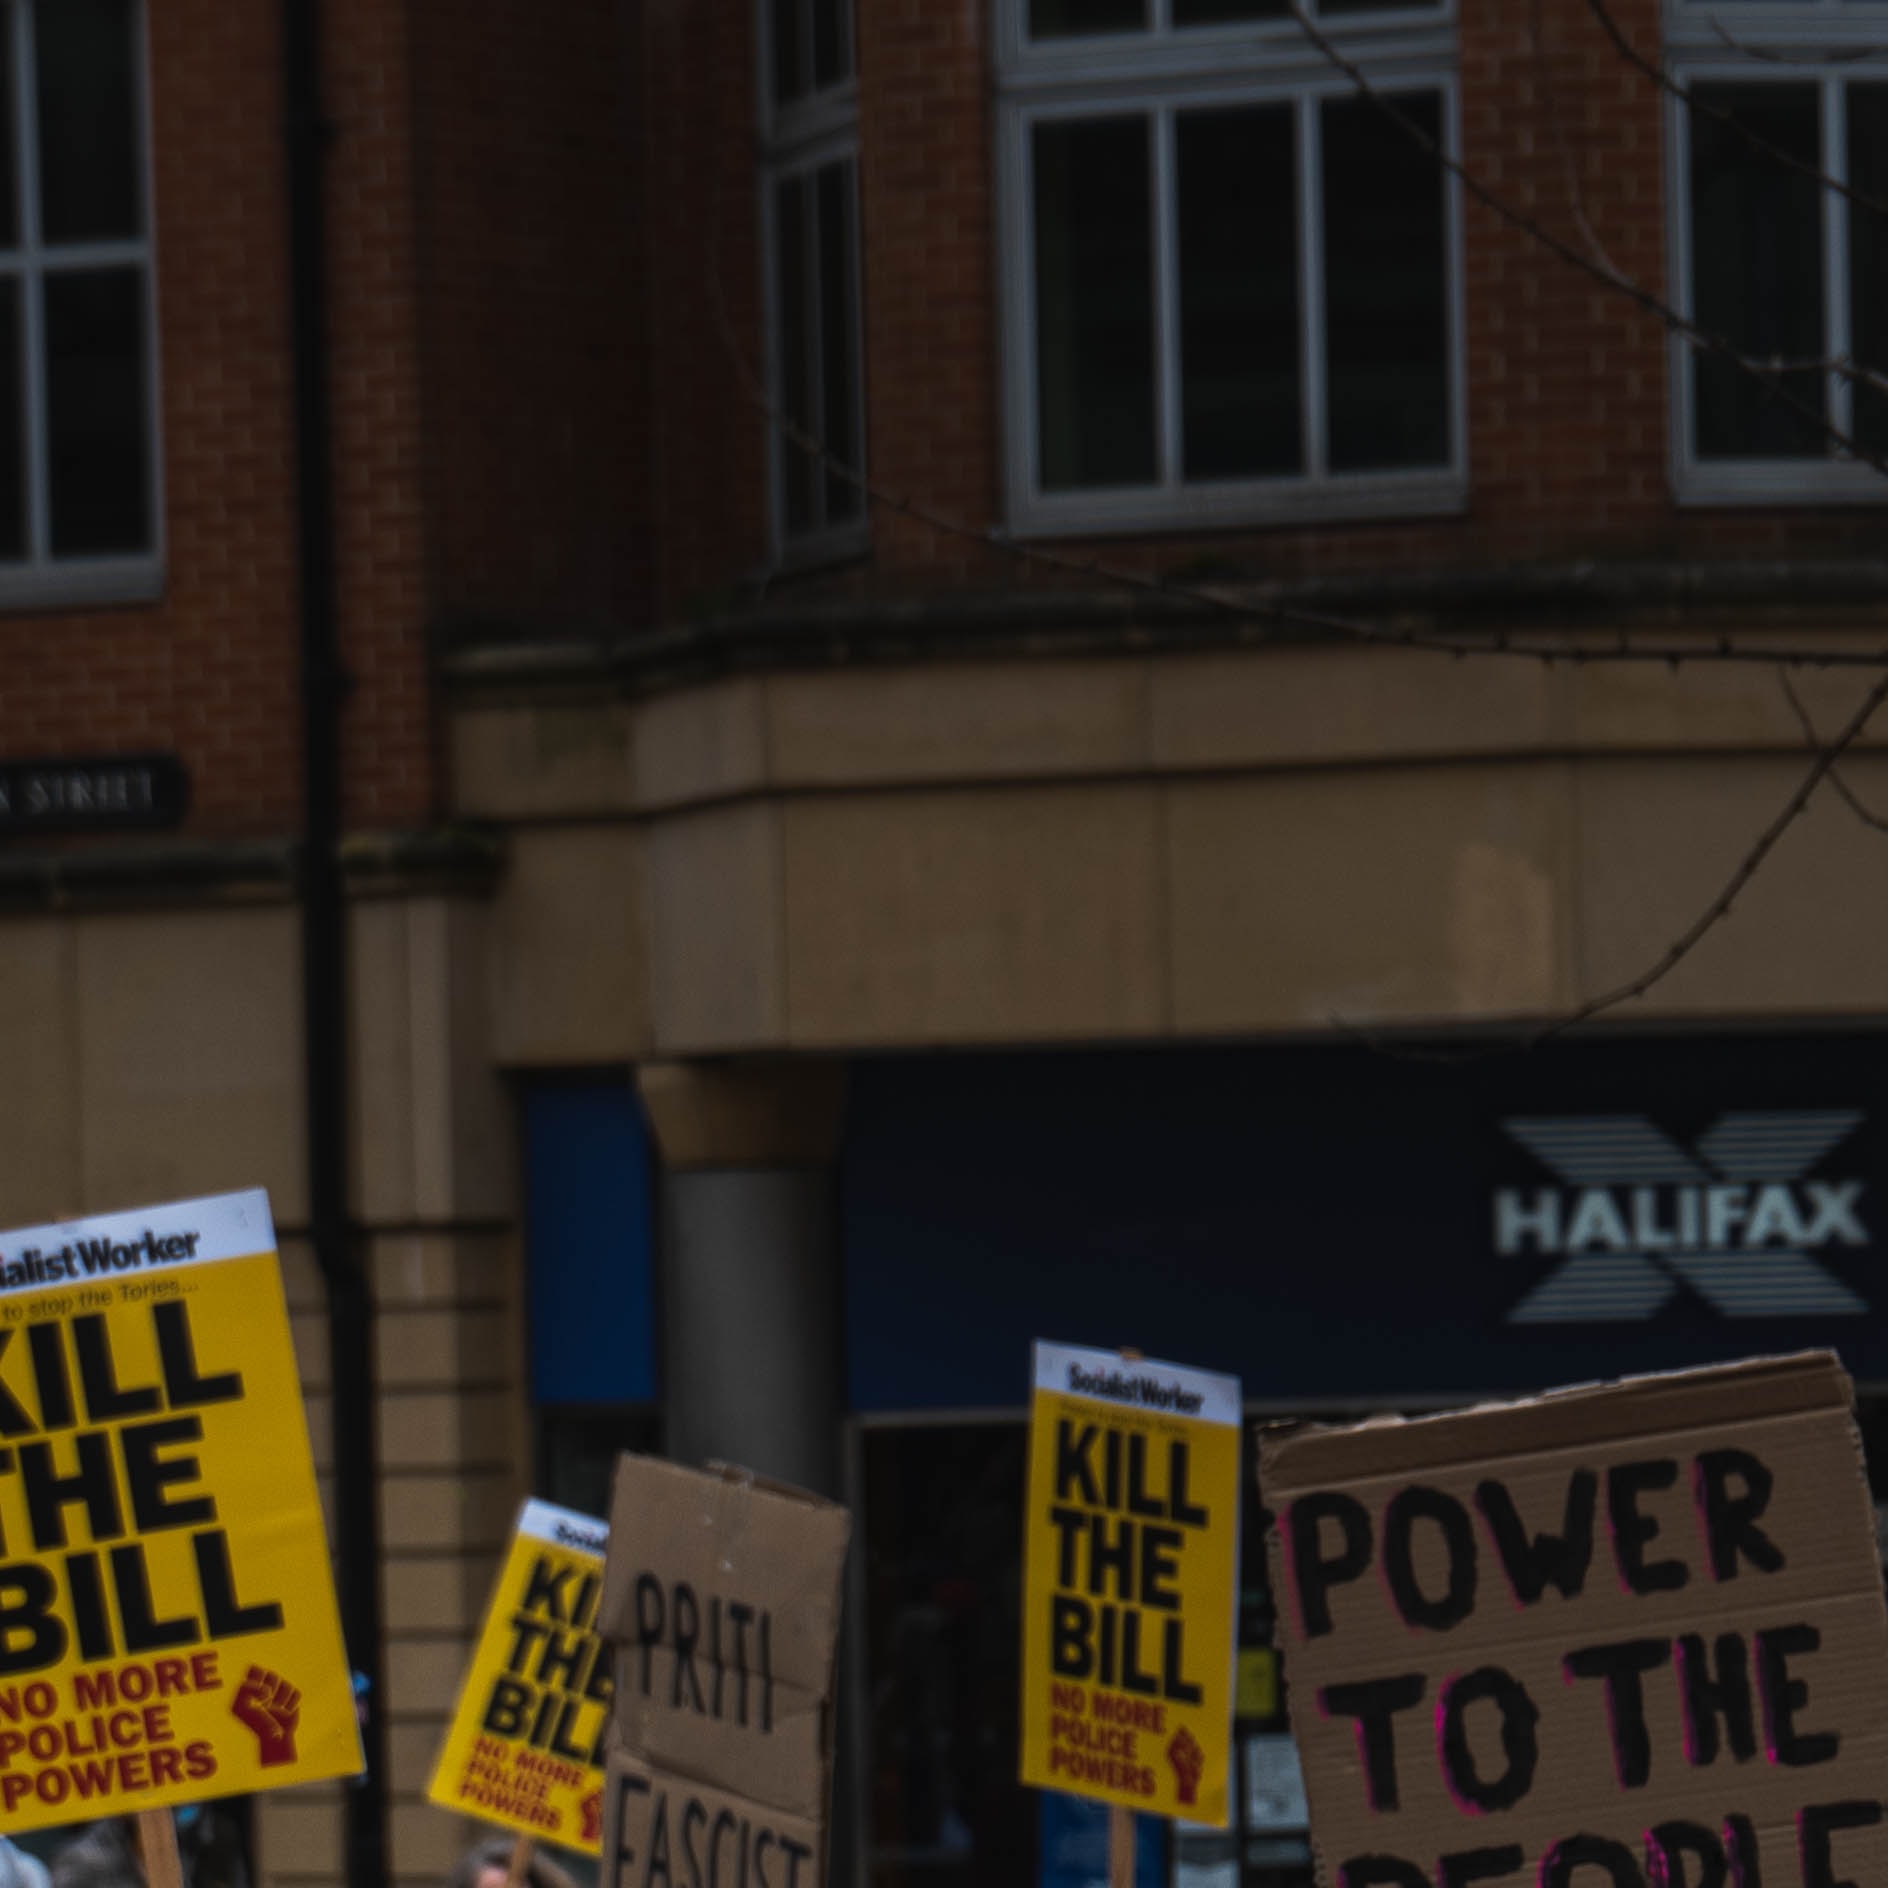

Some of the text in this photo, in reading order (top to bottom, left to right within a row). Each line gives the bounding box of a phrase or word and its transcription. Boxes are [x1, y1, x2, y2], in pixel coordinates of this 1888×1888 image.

[27, 767, 153, 815] STREET
[1491, 1177, 1870, 1258] HALIFAX
[1, 1302, 24, 1321] to
[29, 1293, 74, 1317] stop
[79, 1287, 112, 1307] the
[1056, 1419, 1208, 1527] KILL
[1051, 1506, 1181, 1611] THE
[1277, 1447, 1786, 1641] POWER
[522, 1556, 600, 1630] KI
[73, 1650, 223, 1713] MORE
[636, 1571, 772, 1734] PRITI
[1052, 1595, 1203, 1706] BILL
[1050, 1682, 1166, 1734] NO MORE
[1050, 1714, 1138, 1759] POLICE
[1317, 1623, 1841, 1815] TO THE
[0, 1740, 218, 1813] POWERS
[1050, 1747, 1156, 1797] POWERS
